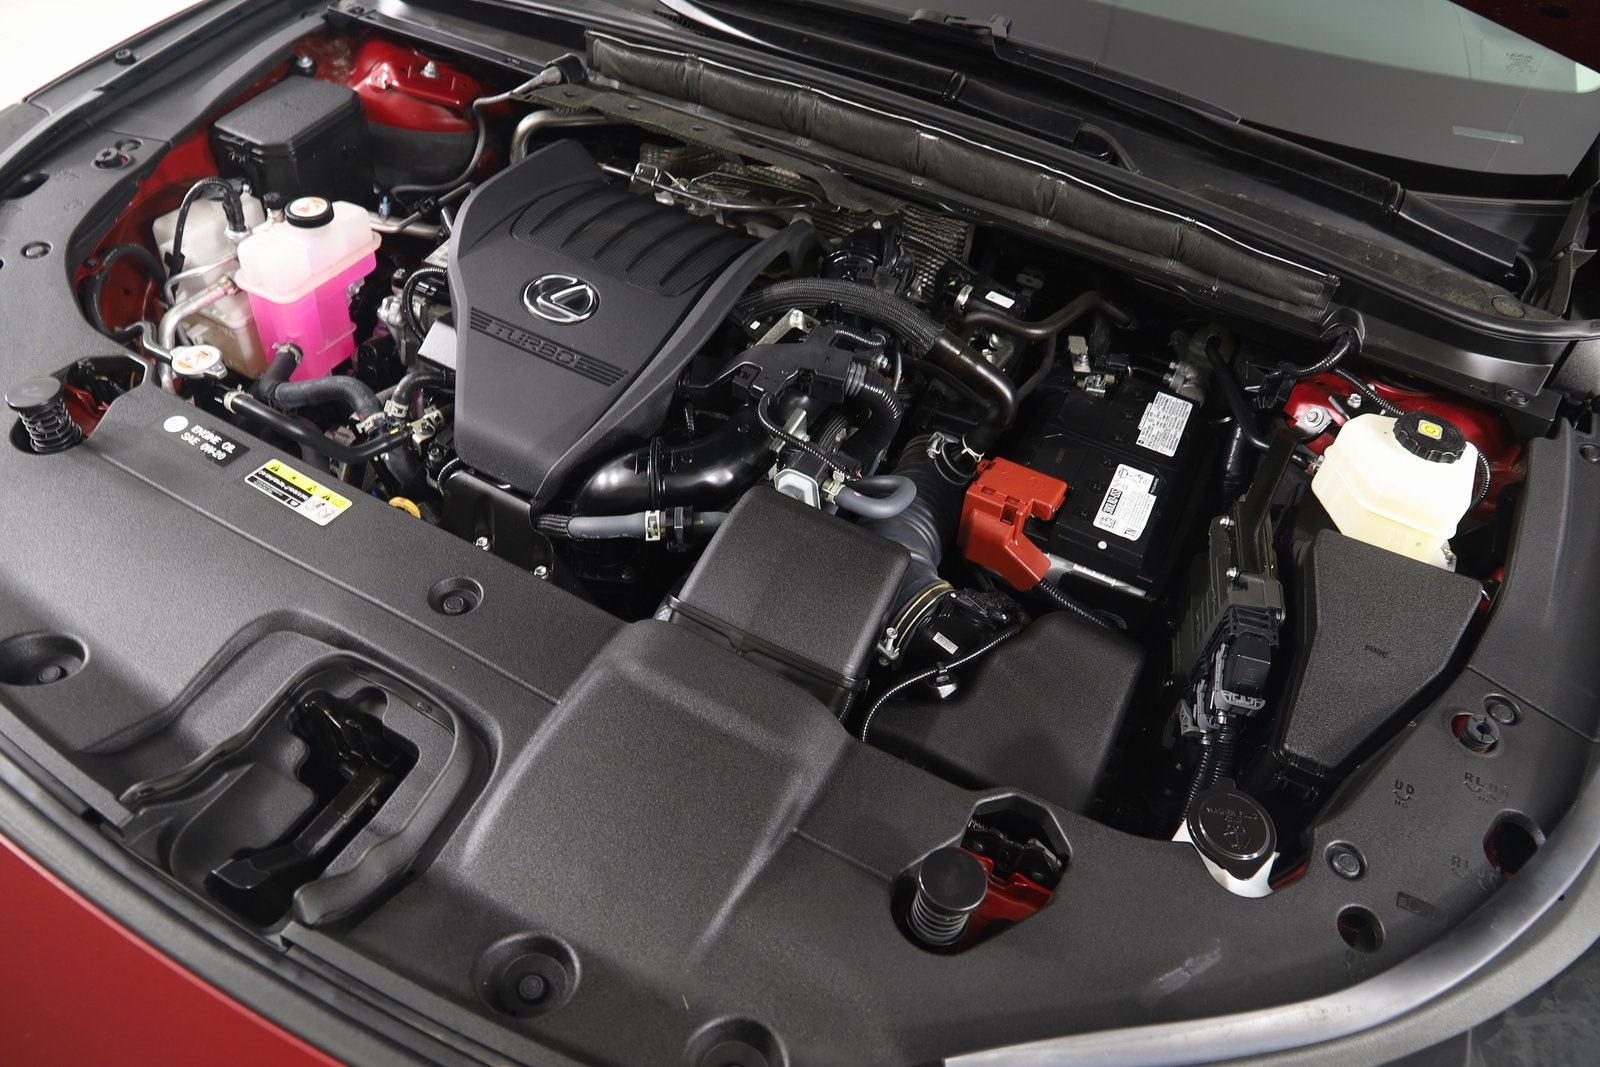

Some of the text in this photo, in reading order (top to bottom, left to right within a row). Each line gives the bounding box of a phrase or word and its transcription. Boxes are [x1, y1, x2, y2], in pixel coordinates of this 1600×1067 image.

[494, 322, 577, 366] TURBO
[181, 432, 201, 446] SAE
[191, 425, 235, 454] ENGINE OIL
